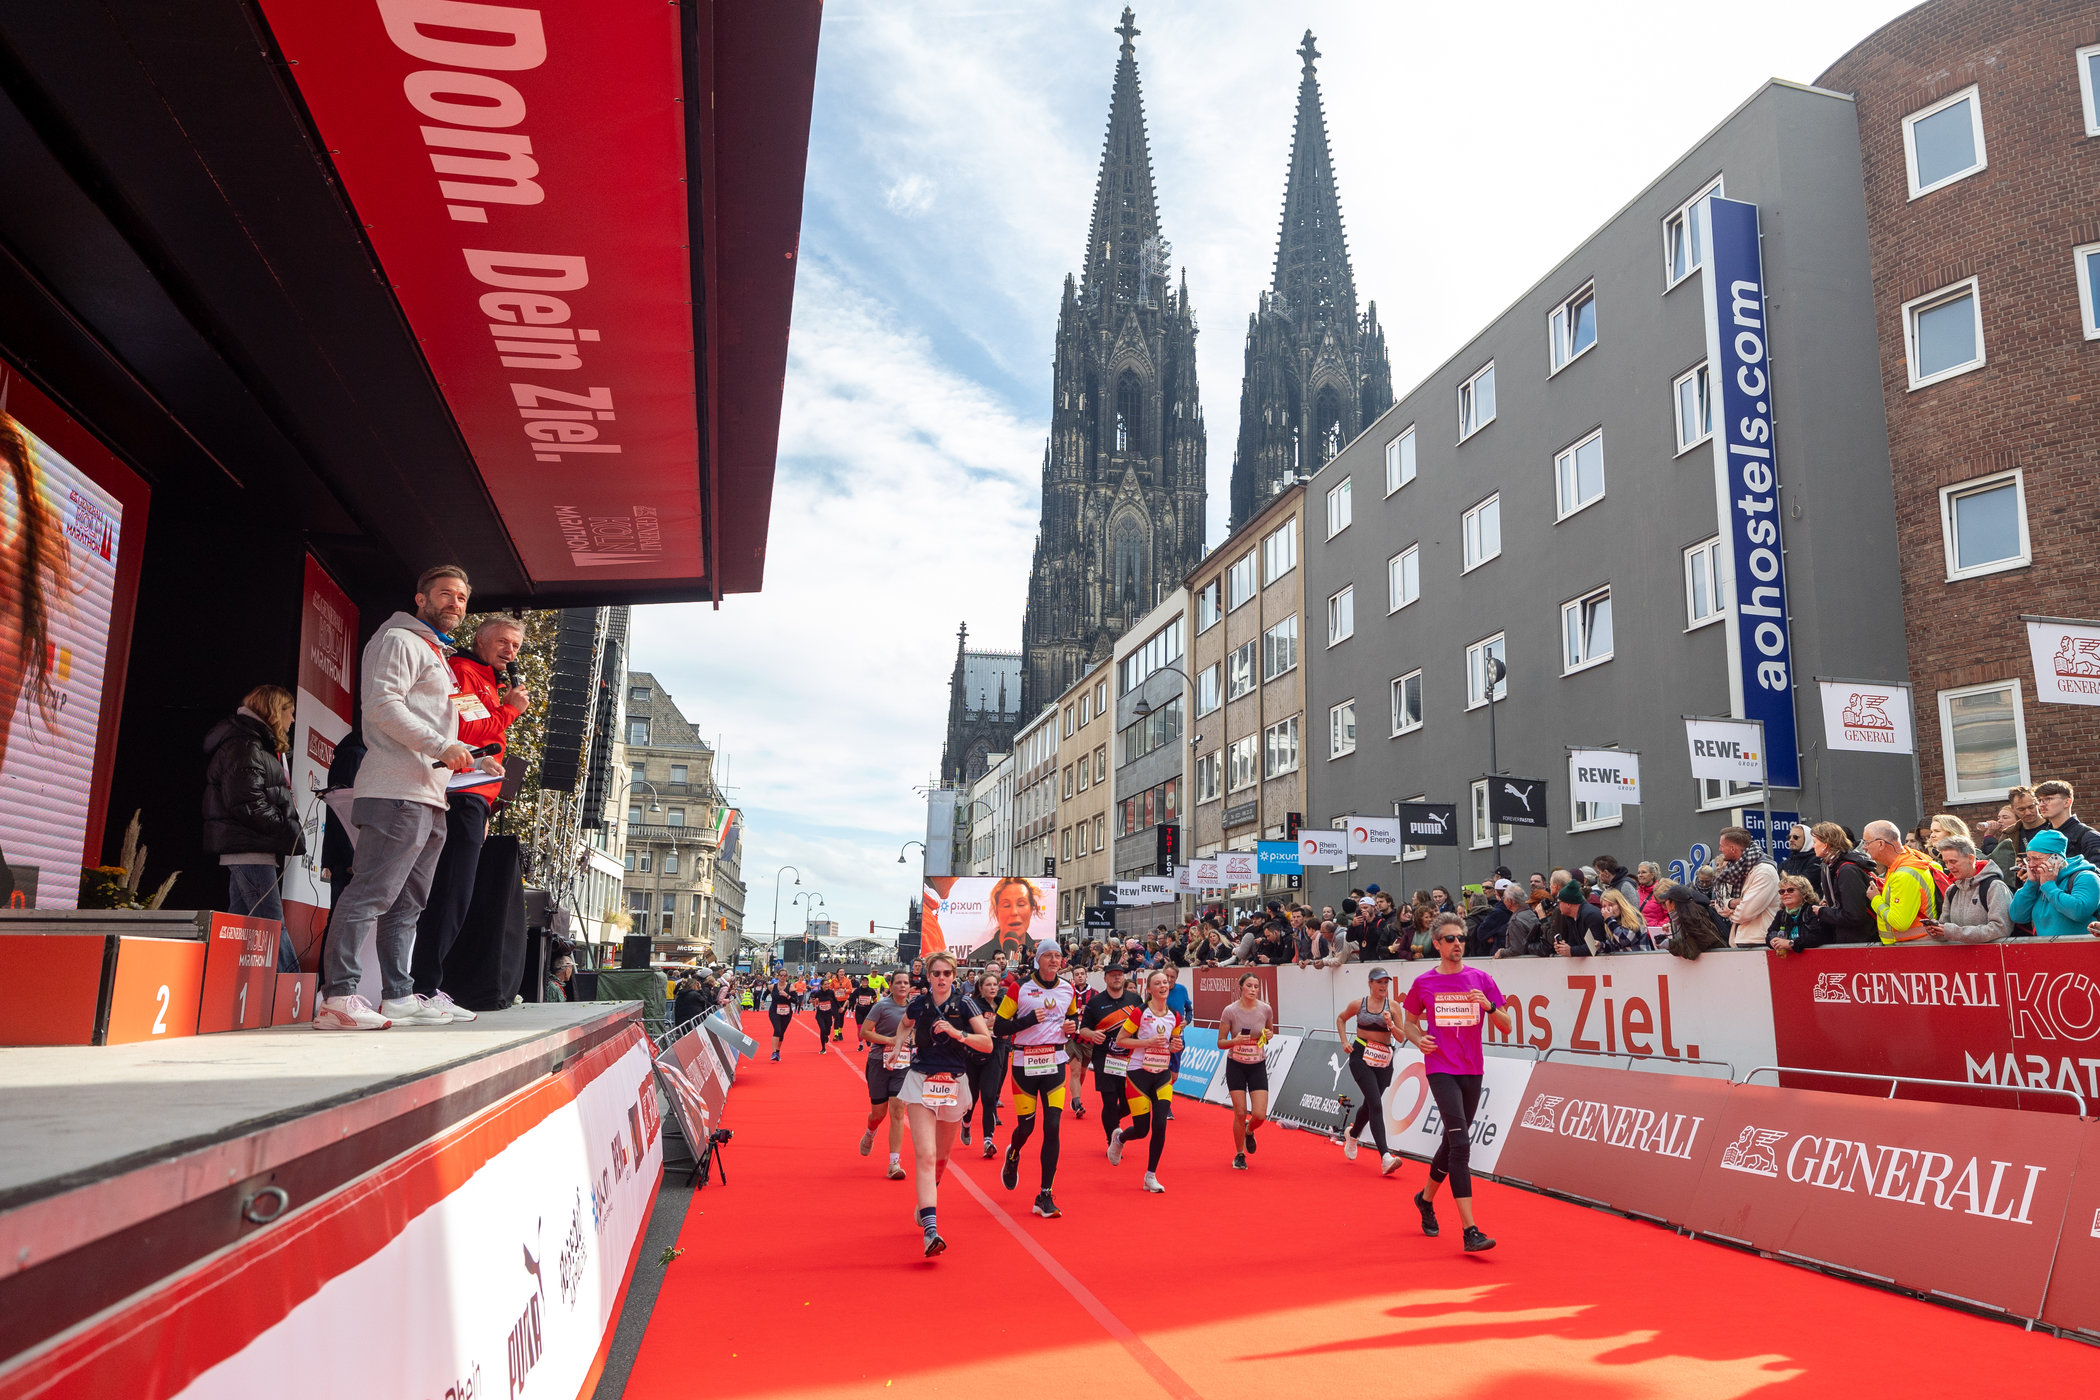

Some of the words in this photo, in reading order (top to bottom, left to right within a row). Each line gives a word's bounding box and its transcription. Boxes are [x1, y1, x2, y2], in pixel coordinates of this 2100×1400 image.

[375, 0, 548, 223] Dom.
[462, 248, 601, 371] Dein
[509, 383, 622, 463] Ziel.
[1730, 279, 1788, 692] aohostels.com
[553, 505, 592, 552] MARATHON
[635, 516, 662, 551] GENERALI
[310, 643, 342, 685] MARATHON
[1844, 729, 1895, 744] GENERALI
[1693, 739, 1742, 759] REWE
[1577, 767, 1621, 784] REWE
[1369, 829, 1390, 837] Rhein
[1410, 822, 1442, 835] PUMA
[1369, 836, 1396, 844] Energie
[1269, 852, 1299, 862] pixum
[1319, 848, 1343, 856] Energie
[1141, 884, 1165, 893] REWE
[950, 901, 982, 914] pixum
[226, 927, 248, 940] GENERALI
[238, 954, 266, 967] MARATHON
[1206, 977, 1231, 992] GENERALI
[1852, 972, 2000, 1007] GENERALI
[239, 983, 248, 1024] 1
[291, 981, 301, 1019] 3
[152, 984, 170, 1035] 2
[1435, 1005, 1470, 1013] Christian
[1567, 974, 1701, 1064] Ziel.
[1027, 1057, 1050, 1065] Peter
[1144, 1056, 1167, 1064] Katharina
[1364, 1049, 1387, 1061] Angela
[929, 1084, 951, 1094] Jule
[1559, 1099, 1705, 1160] GENERALI
[1786, 1134, 2047, 1225] GENERALI
